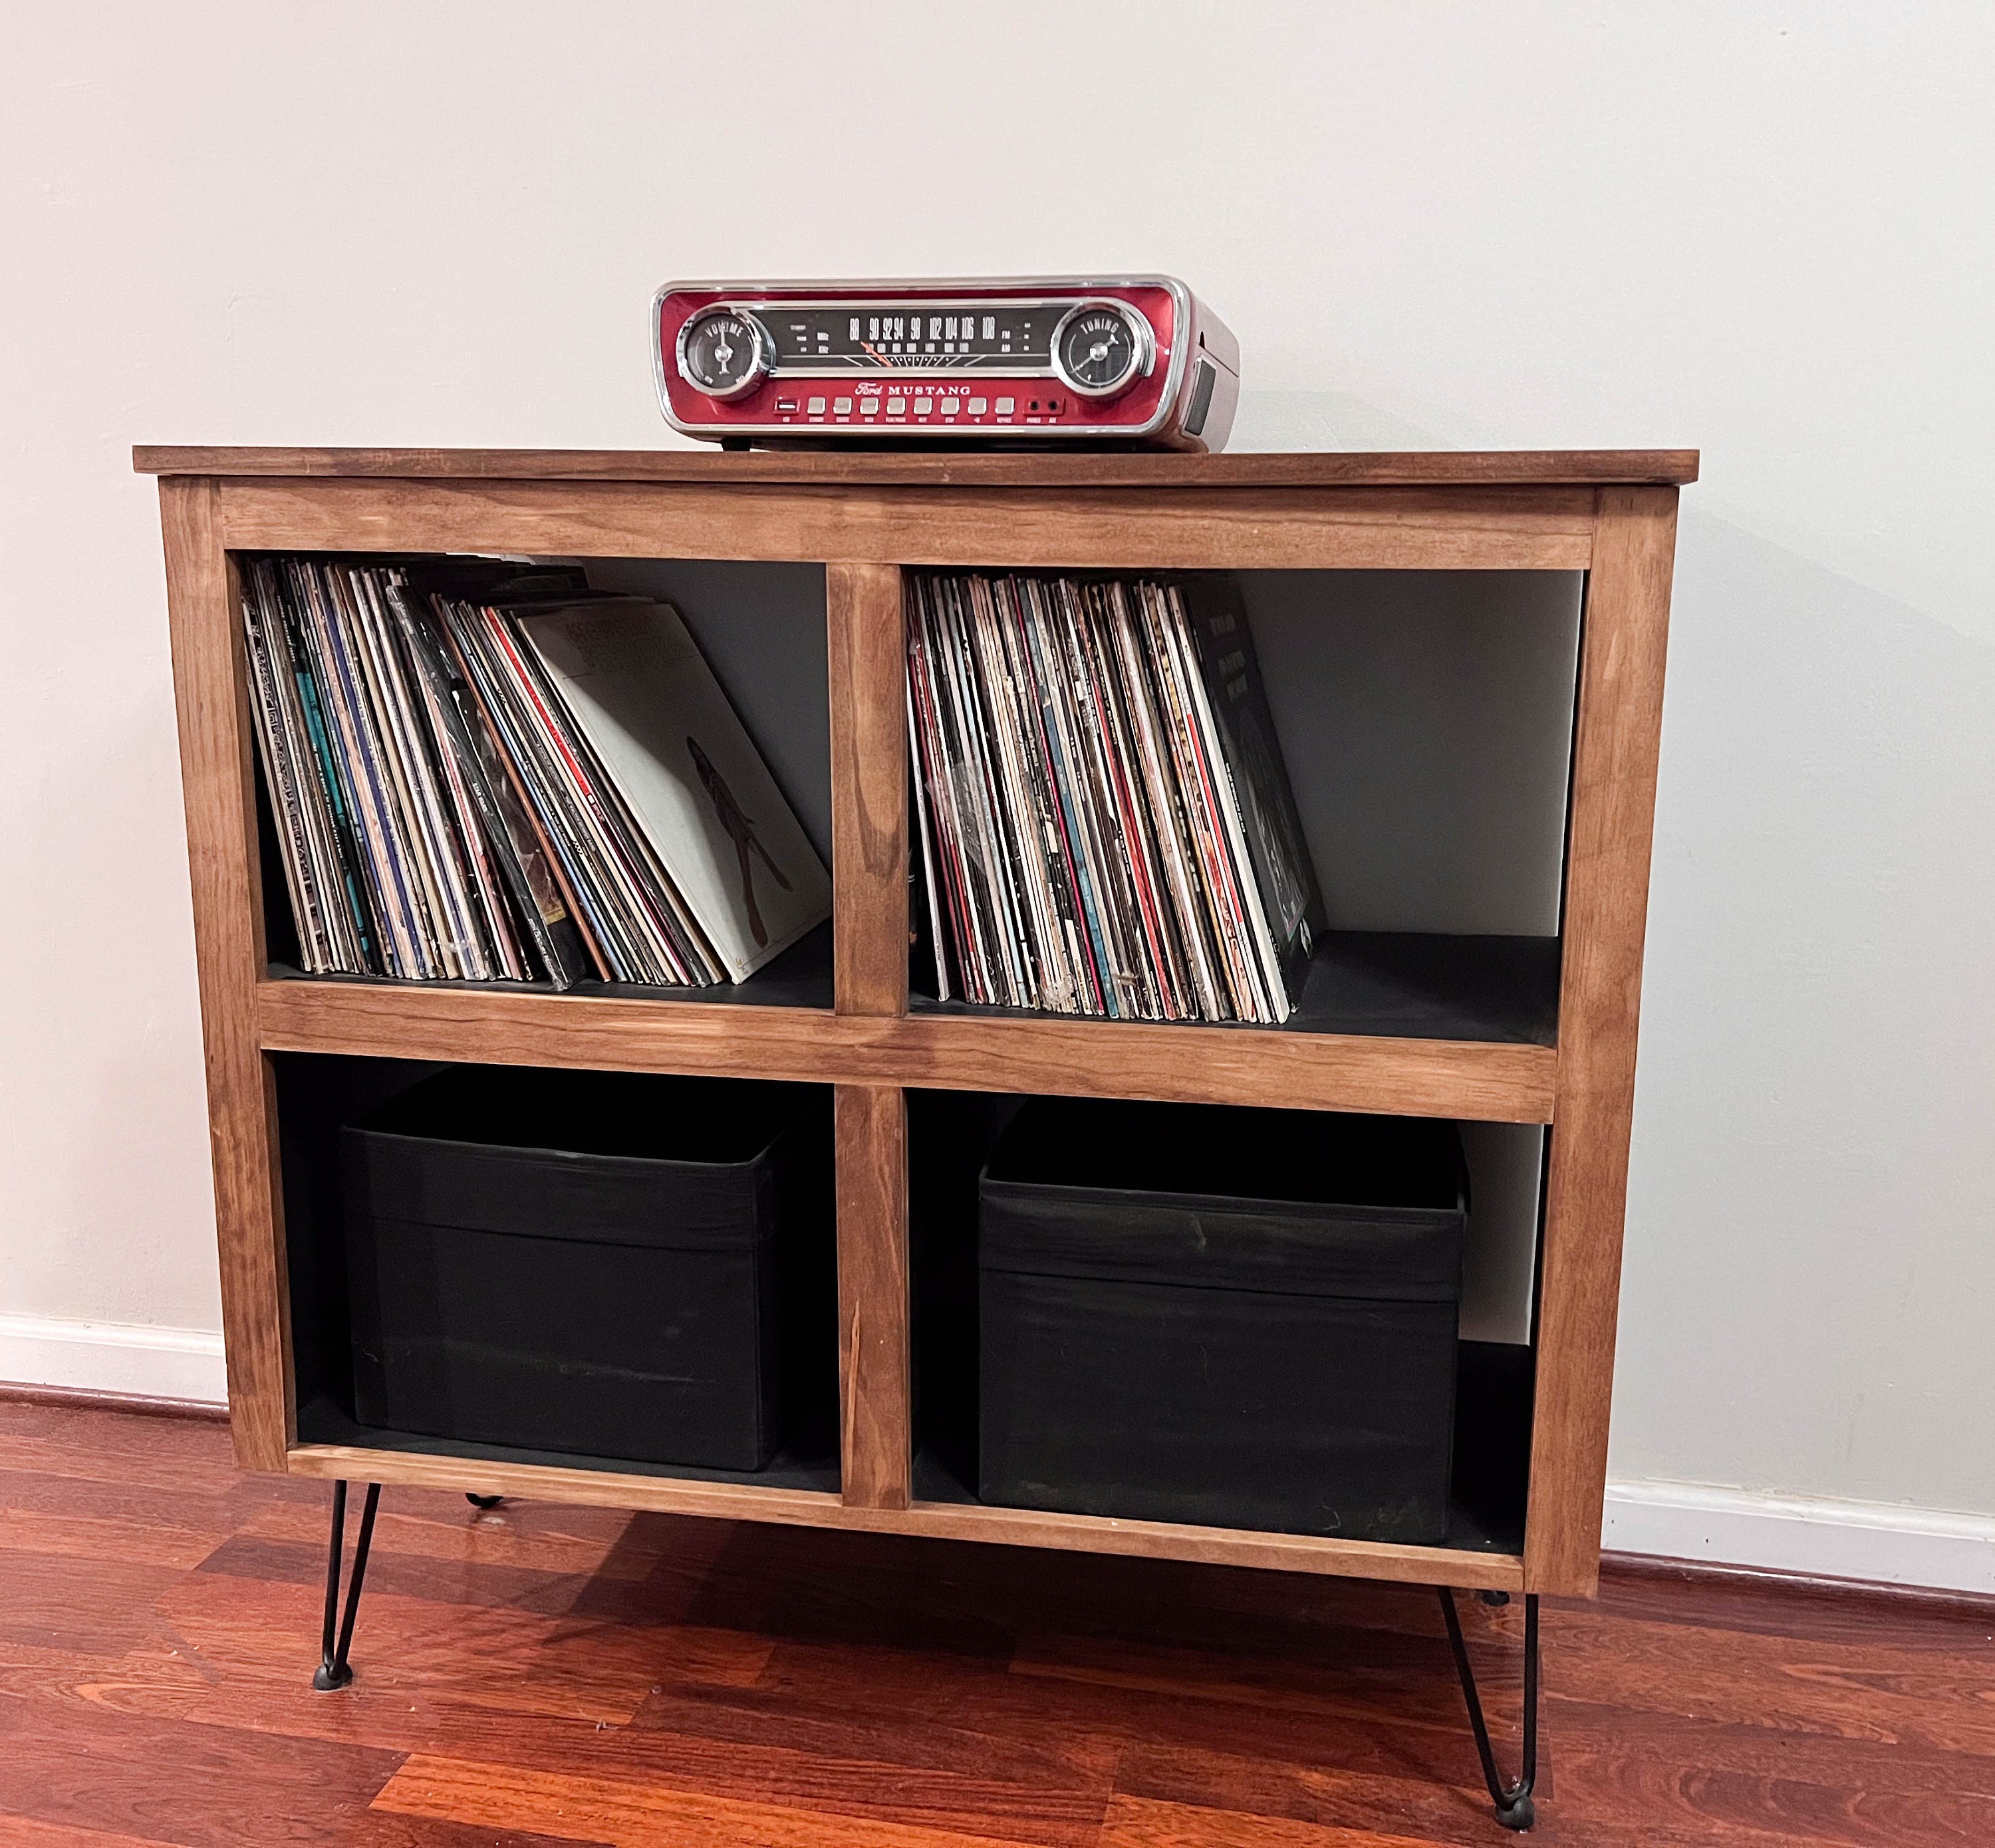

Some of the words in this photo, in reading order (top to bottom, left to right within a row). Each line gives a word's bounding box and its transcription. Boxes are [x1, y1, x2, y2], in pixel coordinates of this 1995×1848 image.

[849, 318, 859, 340] 88
[869, 318, 879, 340] 90
[882, 318, 892, 340] 92
[894, 318, 903, 340] 94
[930, 317, 942, 340] 102
[945, 317, 957, 340] 104
[962, 317, 974, 340] 106
[982, 317, 995, 340] 108
[1081, 319, 1119, 334] TUNING
[855, 382, 883, 395] Ford
[888, 386, 970, 396] MUSTANG
